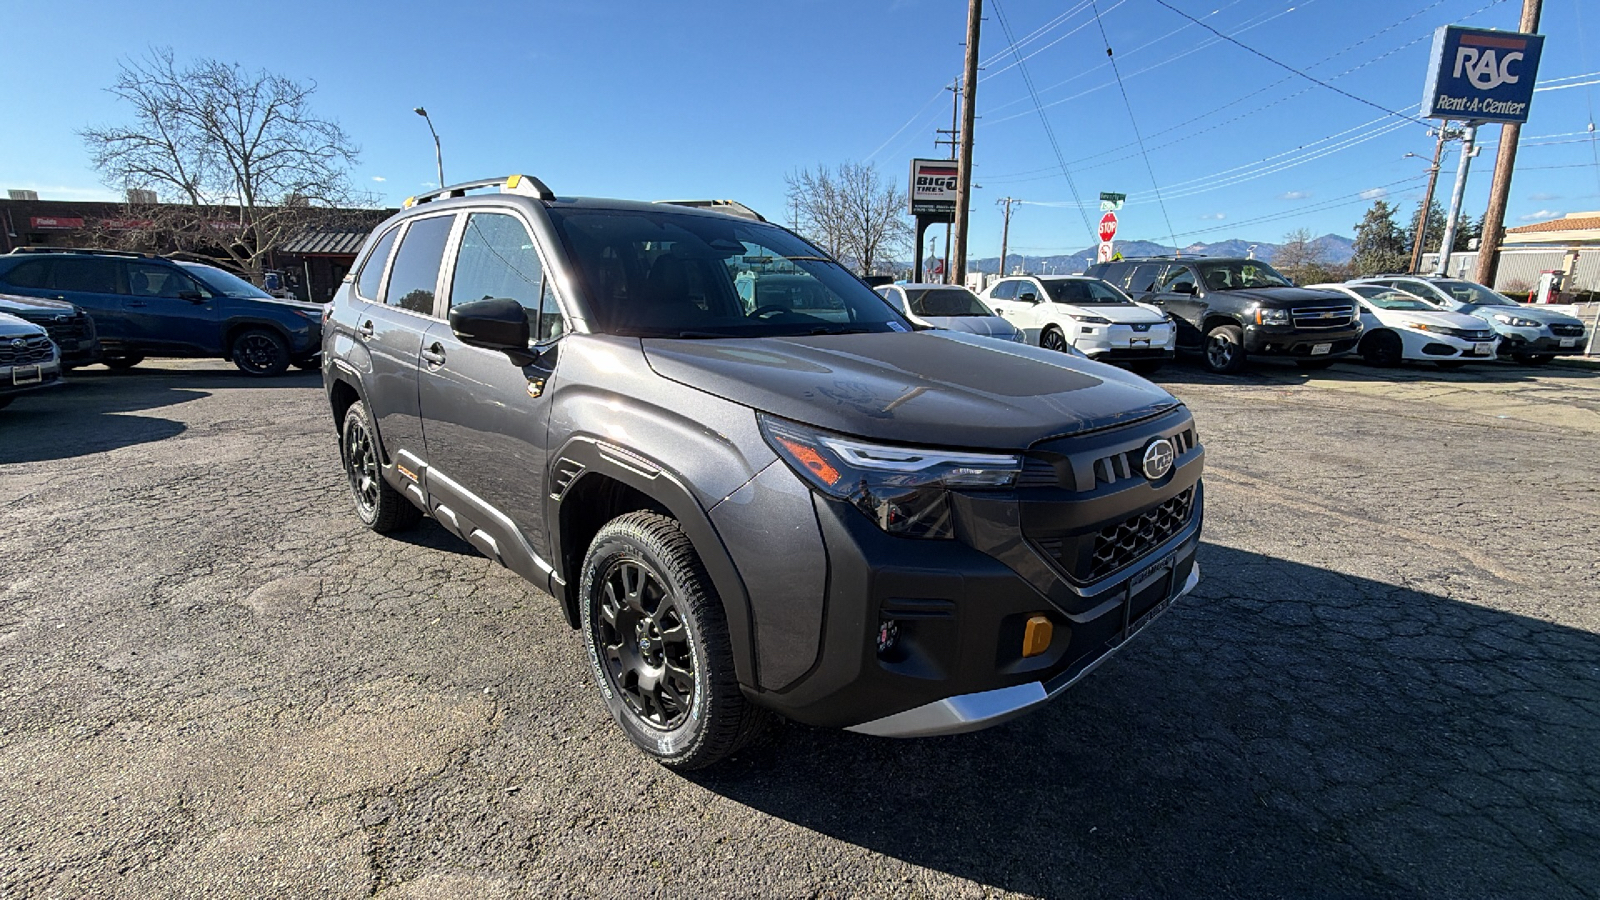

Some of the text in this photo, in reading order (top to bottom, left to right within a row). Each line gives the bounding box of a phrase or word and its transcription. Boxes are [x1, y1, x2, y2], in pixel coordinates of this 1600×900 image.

[1453, 46, 1524, 90] RAC
[916, 176, 946, 187] BIG
[1100, 221, 1117, 234] STOP
